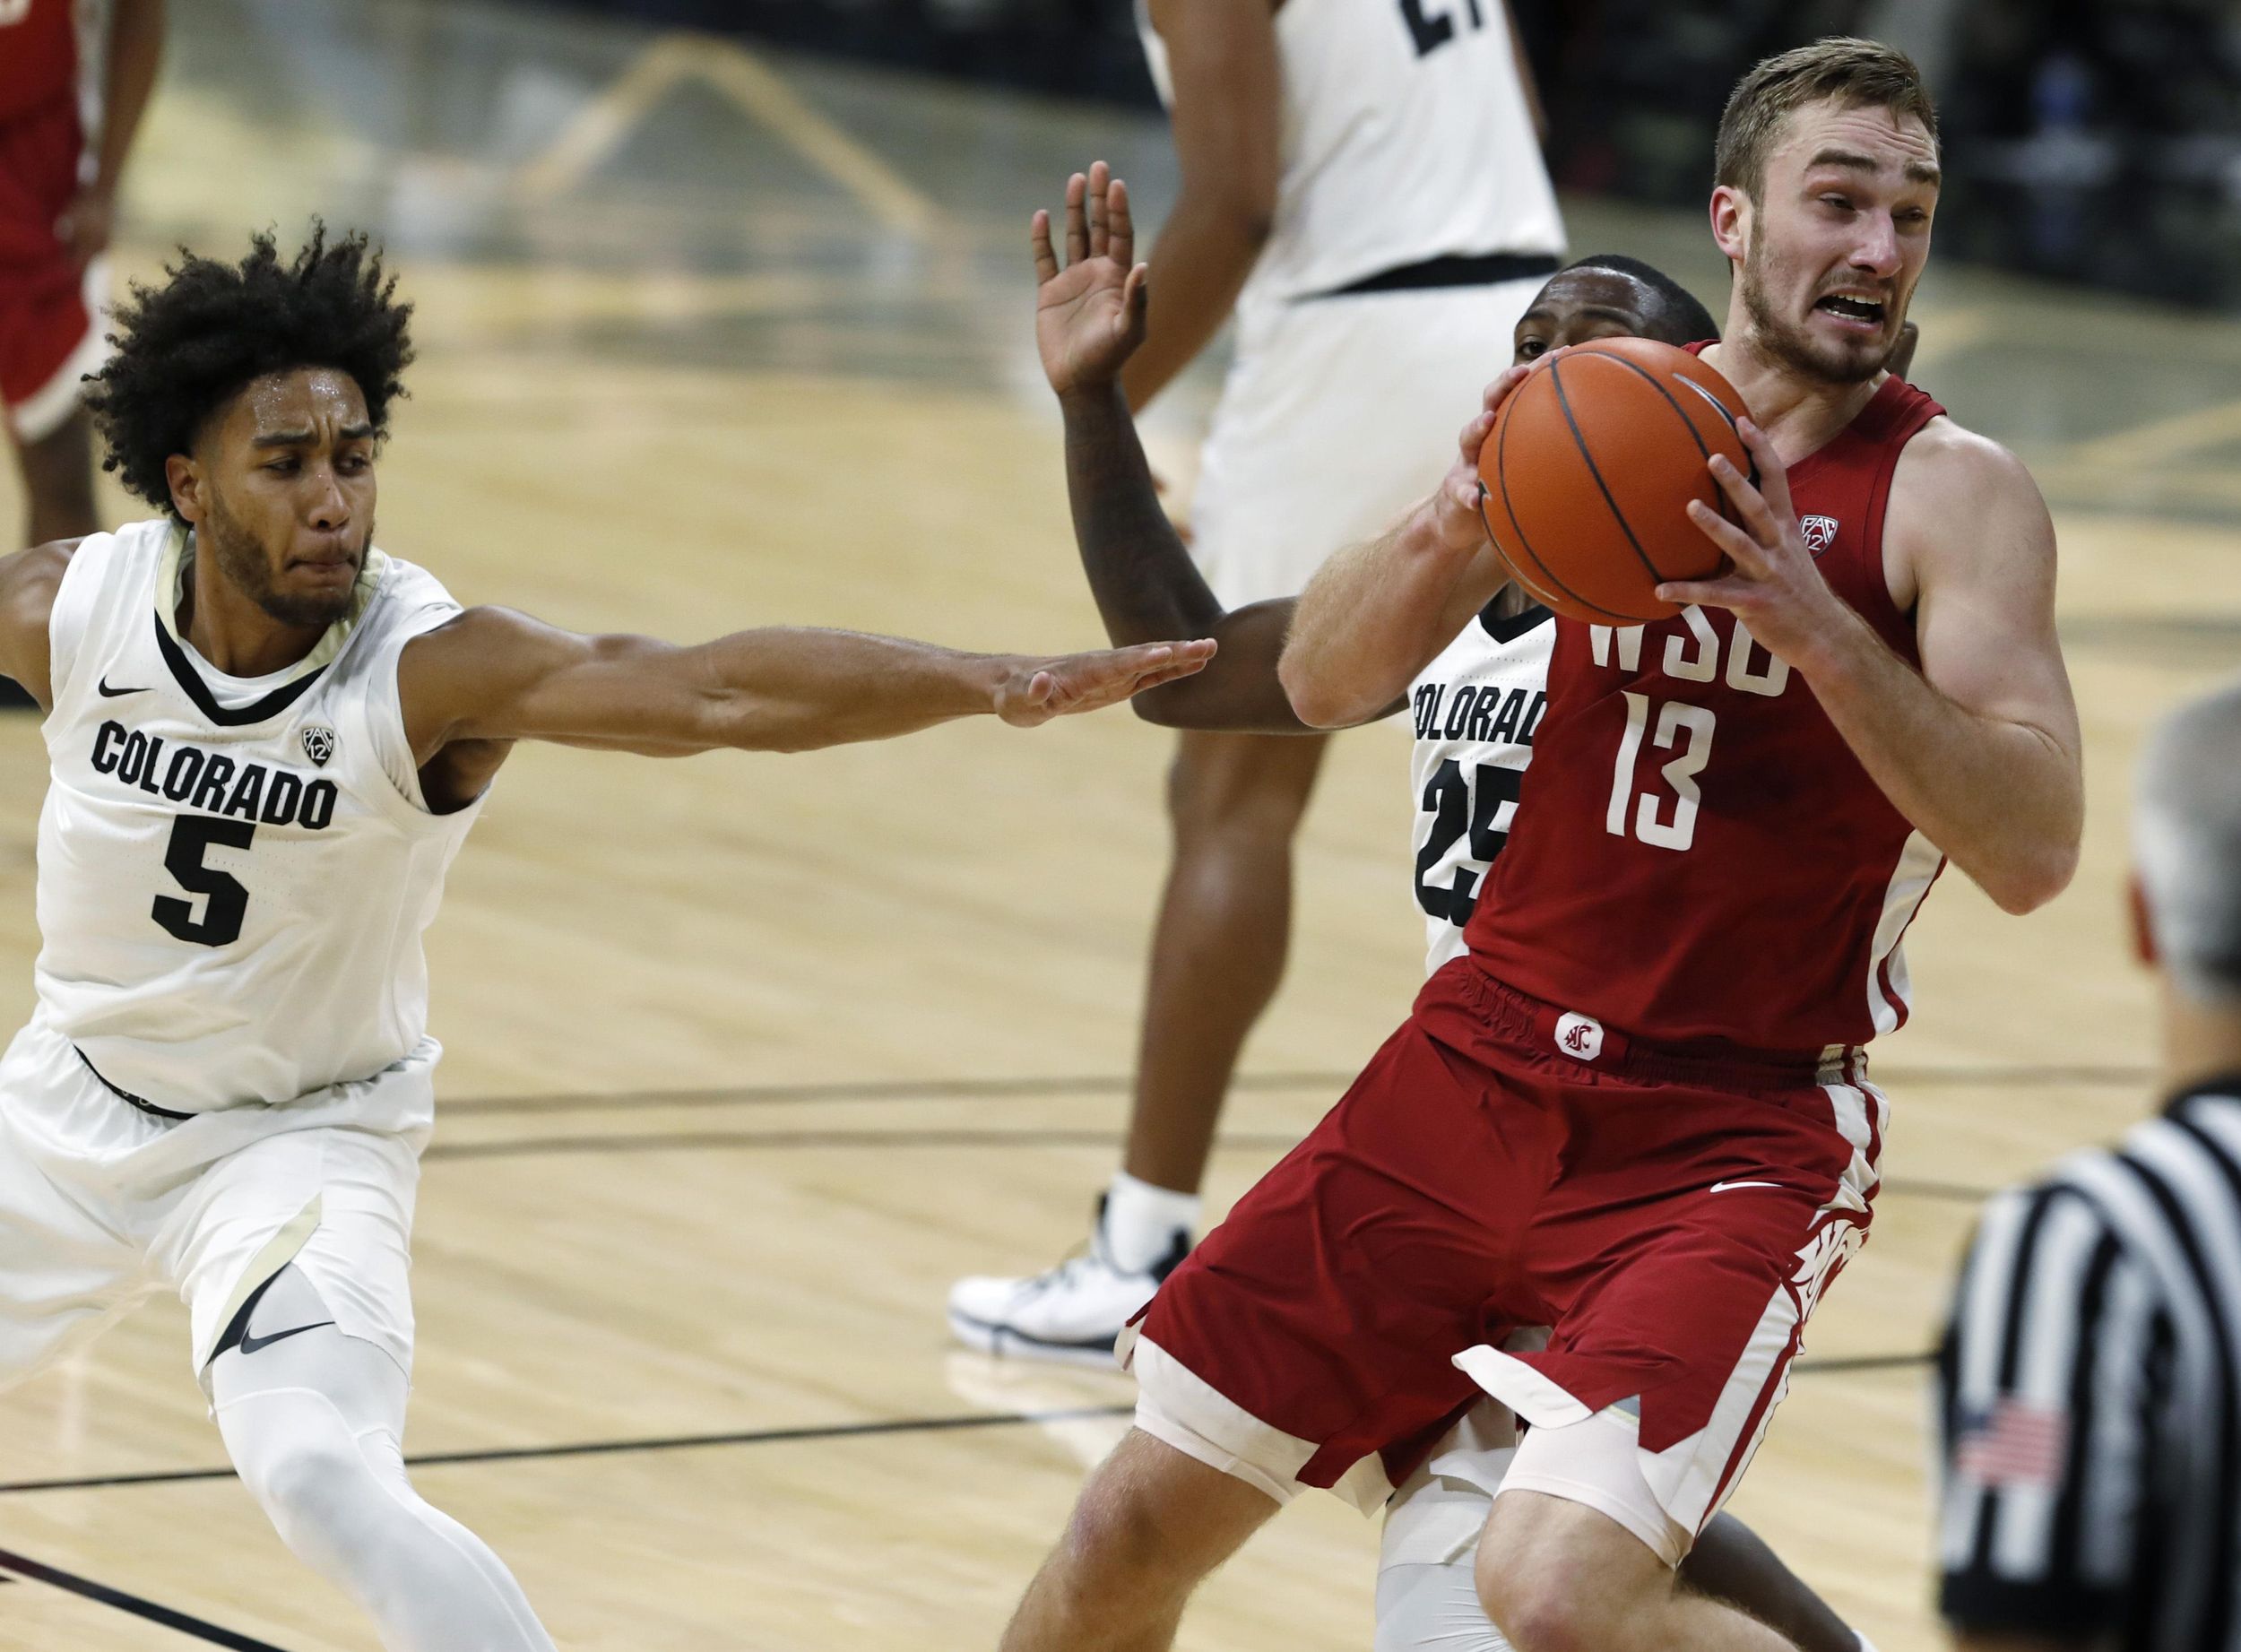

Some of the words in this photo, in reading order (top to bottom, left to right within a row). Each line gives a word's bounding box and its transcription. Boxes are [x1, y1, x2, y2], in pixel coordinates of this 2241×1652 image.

[1802, 516, 1836, 544] PAC
[1805, 533, 1823, 551] 12
[303, 727, 333, 752] PAC
[1414, 683, 1546, 747] OLORAD
[91, 720, 338, 830] COLORADO
[310, 743, 327, 760] 12
[1606, 690, 1716, 852] 13
[1415, 758, 1524, 928] 25
[151, 814, 256, 947] 5
